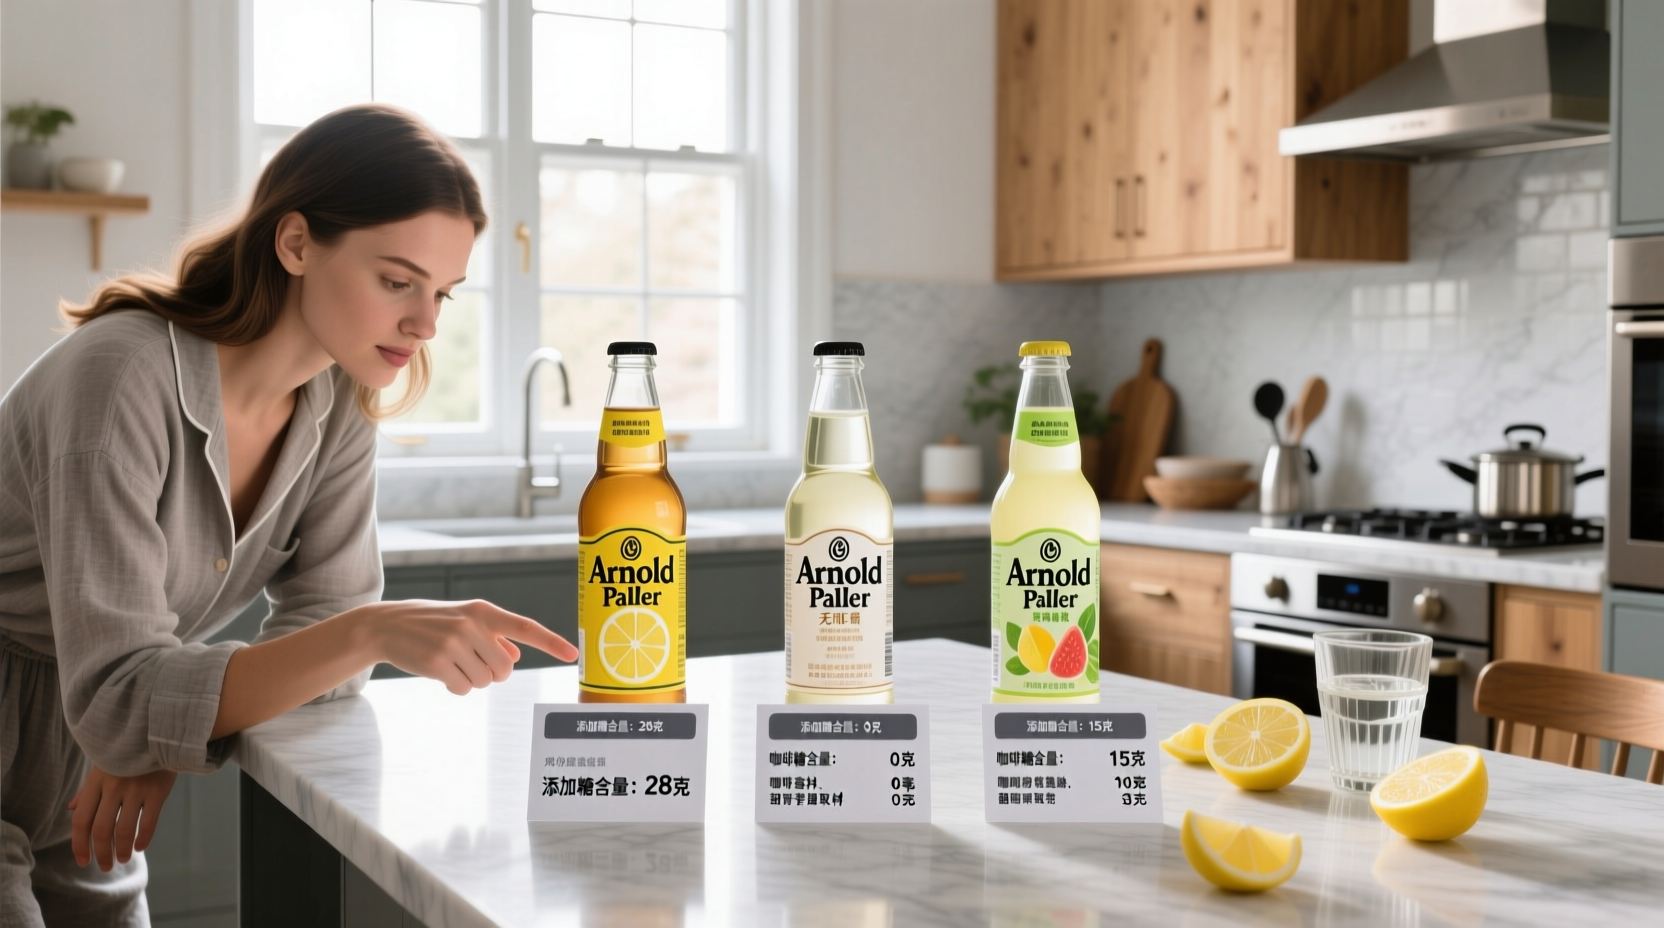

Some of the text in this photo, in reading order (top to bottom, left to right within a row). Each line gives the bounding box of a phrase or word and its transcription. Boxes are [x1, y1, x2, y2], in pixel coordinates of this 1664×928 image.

[588, 555, 674, 584] Arnold
[796, 555, 882, 585] Arnold
[1006, 557, 1091, 587] Arnold
[602, 586, 662, 607] Paller
[809, 587, 871, 608] Paller
[1023, 589, 1079, 609] Paller
[889, 751, 916, 767] 0克
[1109, 750, 1146, 767] 15克
